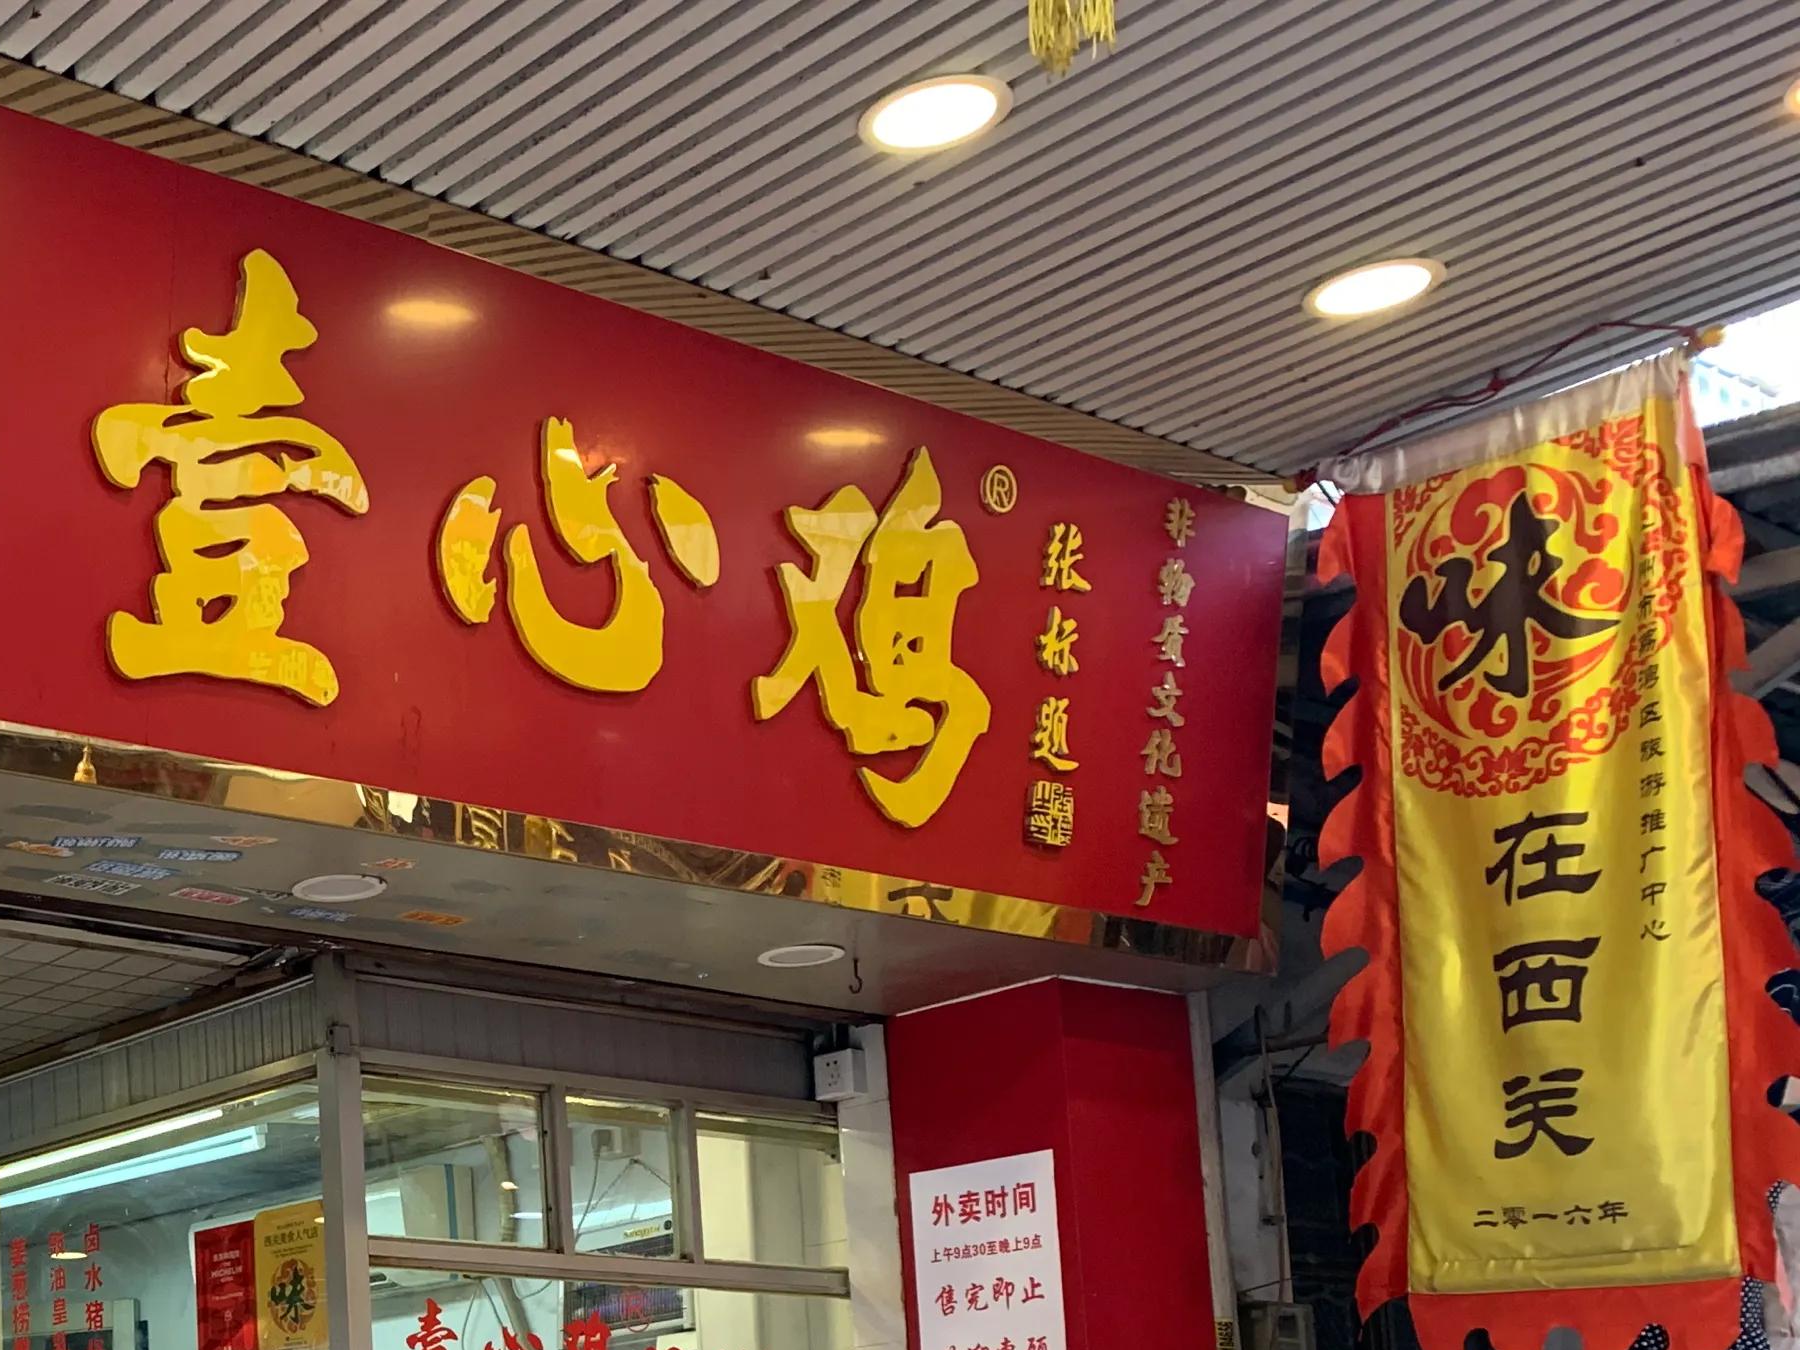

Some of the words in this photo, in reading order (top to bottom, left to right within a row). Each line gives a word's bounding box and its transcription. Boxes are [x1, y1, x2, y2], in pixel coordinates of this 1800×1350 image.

[92, 247, 991, 828] 壹心鸡
[1134, 497, 1196, 906] 非物质文化遗产
[1399, 490, 1621, 1160] 味在西关
[931, 1181, 1037, 1228] 外卖时间
[1473, 1199, 1629, 1229] 二零一六年
[930, 1232, 1043, 1265] 上午9点30至晚上9点
[934, 1275, 1046, 1318] 售完即止
